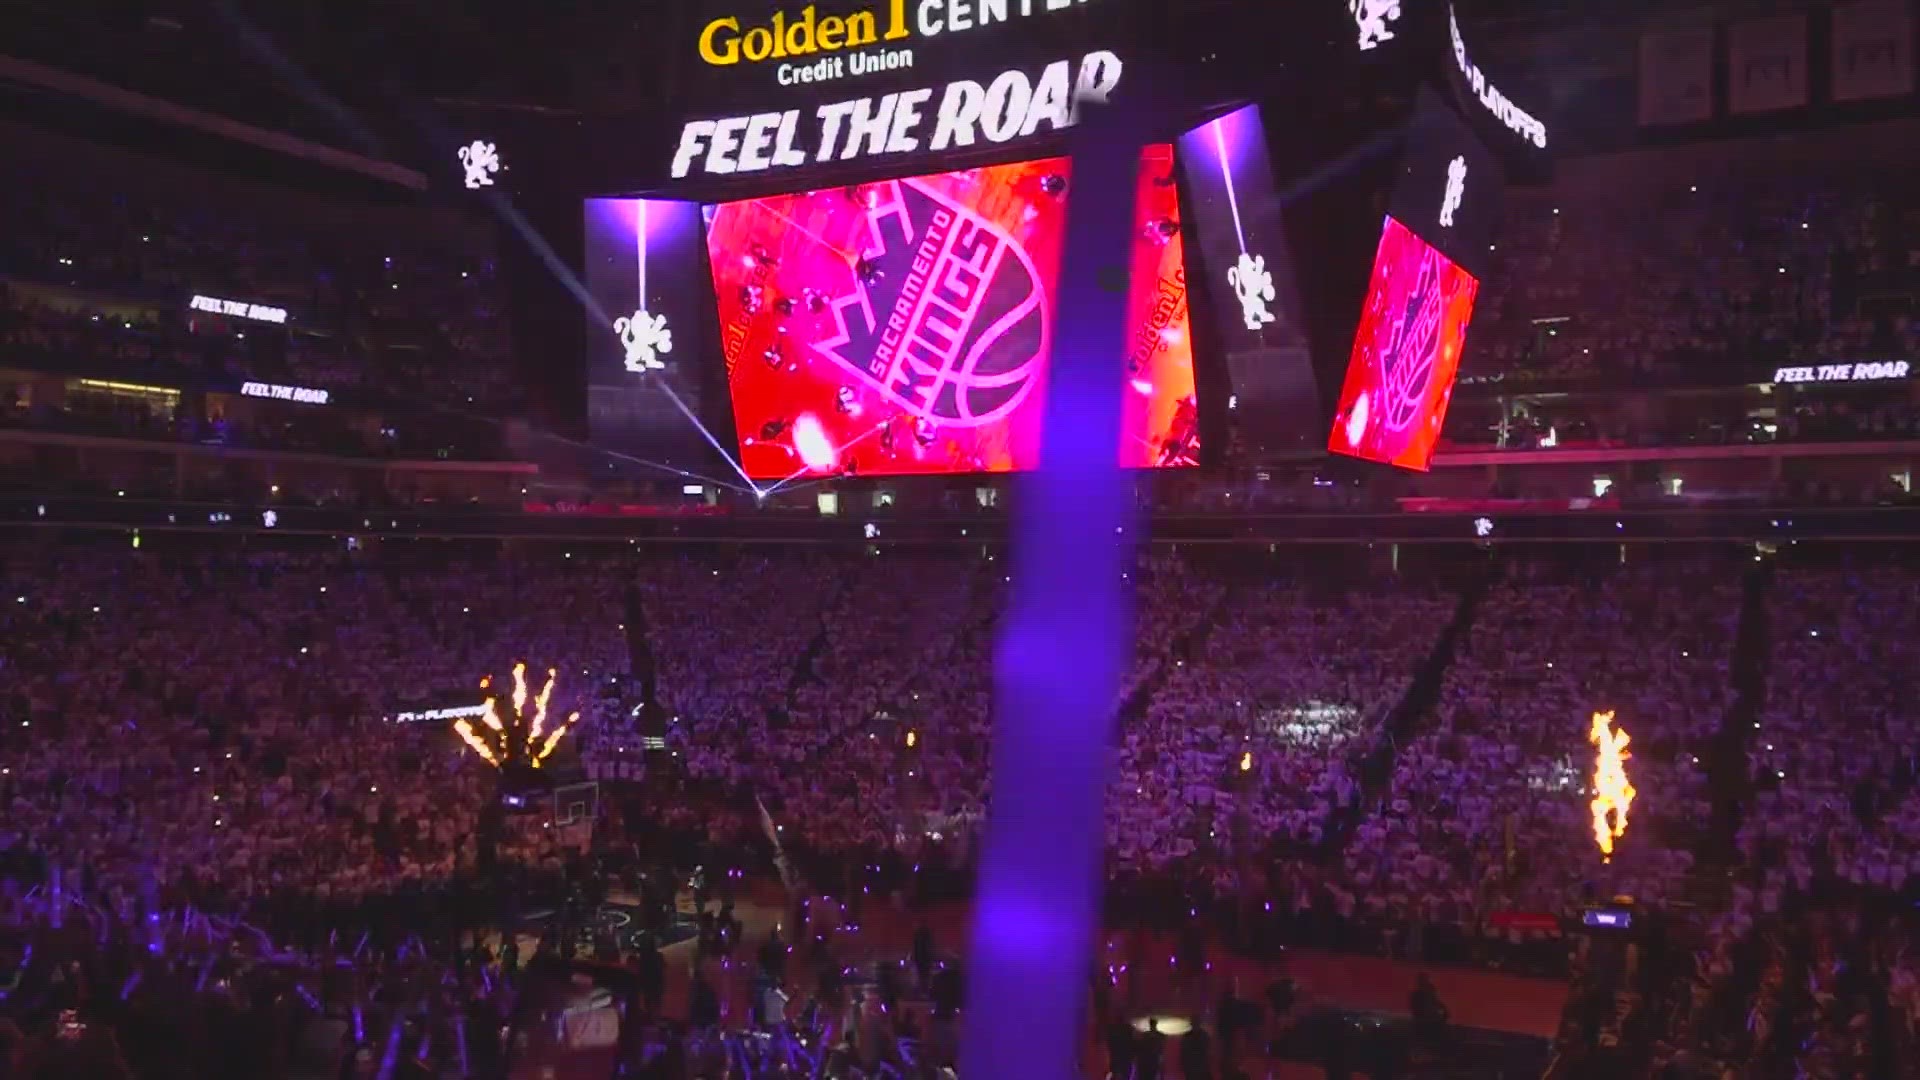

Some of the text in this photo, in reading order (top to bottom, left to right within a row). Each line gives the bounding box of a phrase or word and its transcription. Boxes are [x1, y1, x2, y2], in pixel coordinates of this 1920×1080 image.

[699, 4, 878, 65] Golden
[777, 48, 913, 85] Credit Union
[671, 110, 806, 178] FEEL
[815, 88, 932, 162] THE
[869, 209, 950, 378] SACRAMENTO
[891, 217, 1000, 411] KINGS
[1774, 360, 1909, 383] FEEL THE ROAR
